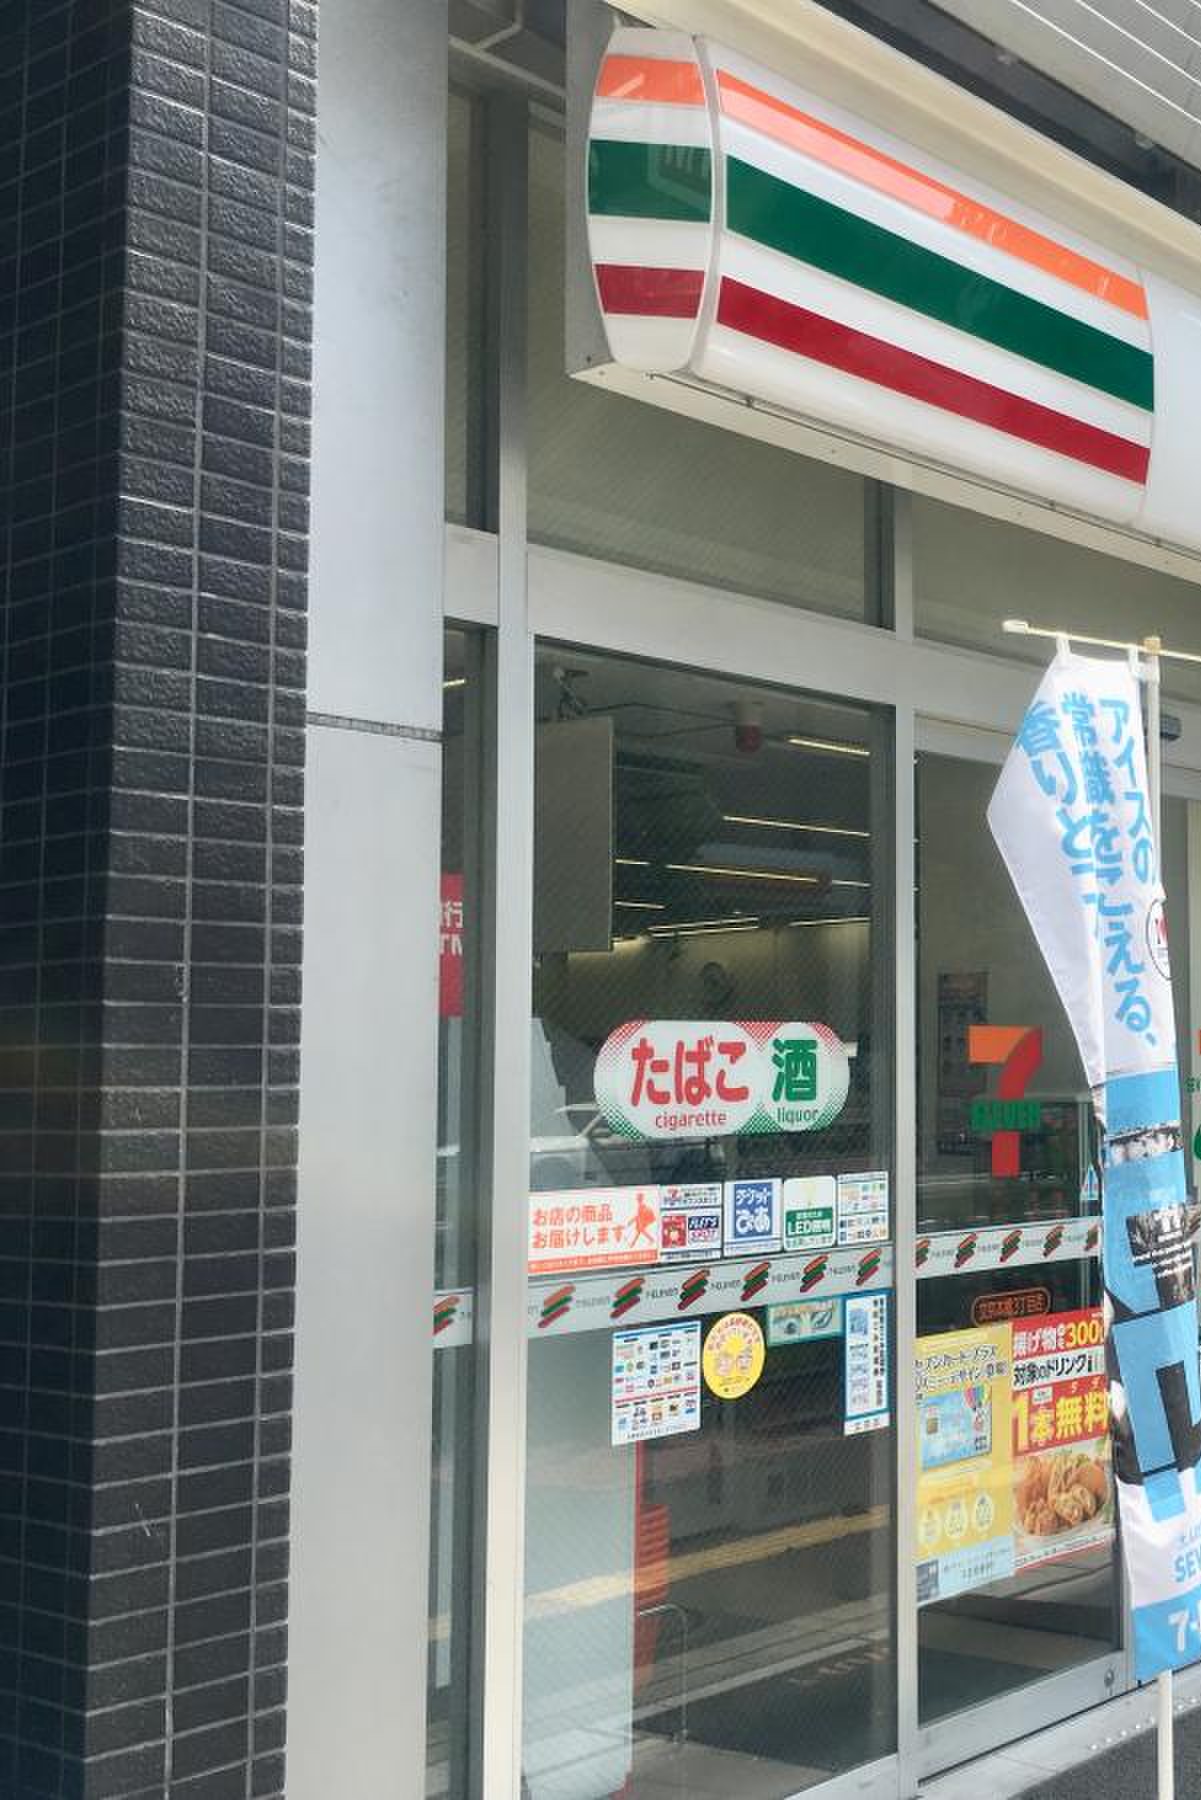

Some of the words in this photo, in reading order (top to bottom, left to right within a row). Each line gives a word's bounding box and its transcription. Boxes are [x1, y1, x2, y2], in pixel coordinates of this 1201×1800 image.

[631, 1036, 750, 1107] たばこ
[771, 1038, 818, 1103] 酒
[655, 1109, 727, 1130] cigarette
[777, 1107, 819, 1125] liquor
